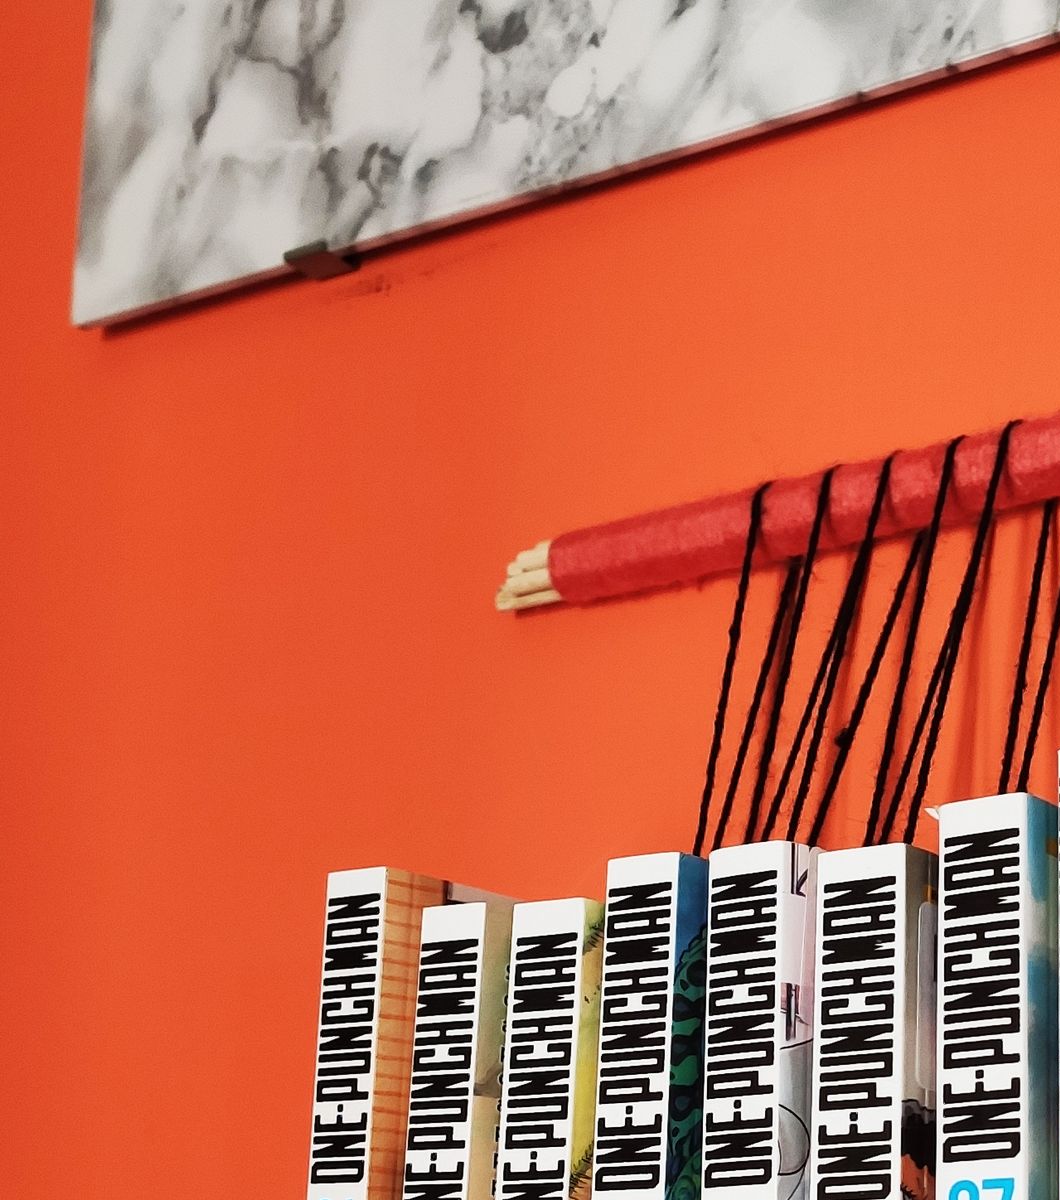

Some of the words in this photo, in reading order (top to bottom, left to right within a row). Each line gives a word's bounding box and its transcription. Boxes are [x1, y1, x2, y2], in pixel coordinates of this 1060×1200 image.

[710, 870, 777, 957] MAN
[944, 828, 1019, 920] MAN
[325, 893, 380, 971] MAN
[605, 882, 672, 965] MAN
[822, 876, 896, 965] MAN
[417, 939, 478, 1017] MAN
[513, 933, 578, 1013] MAN
